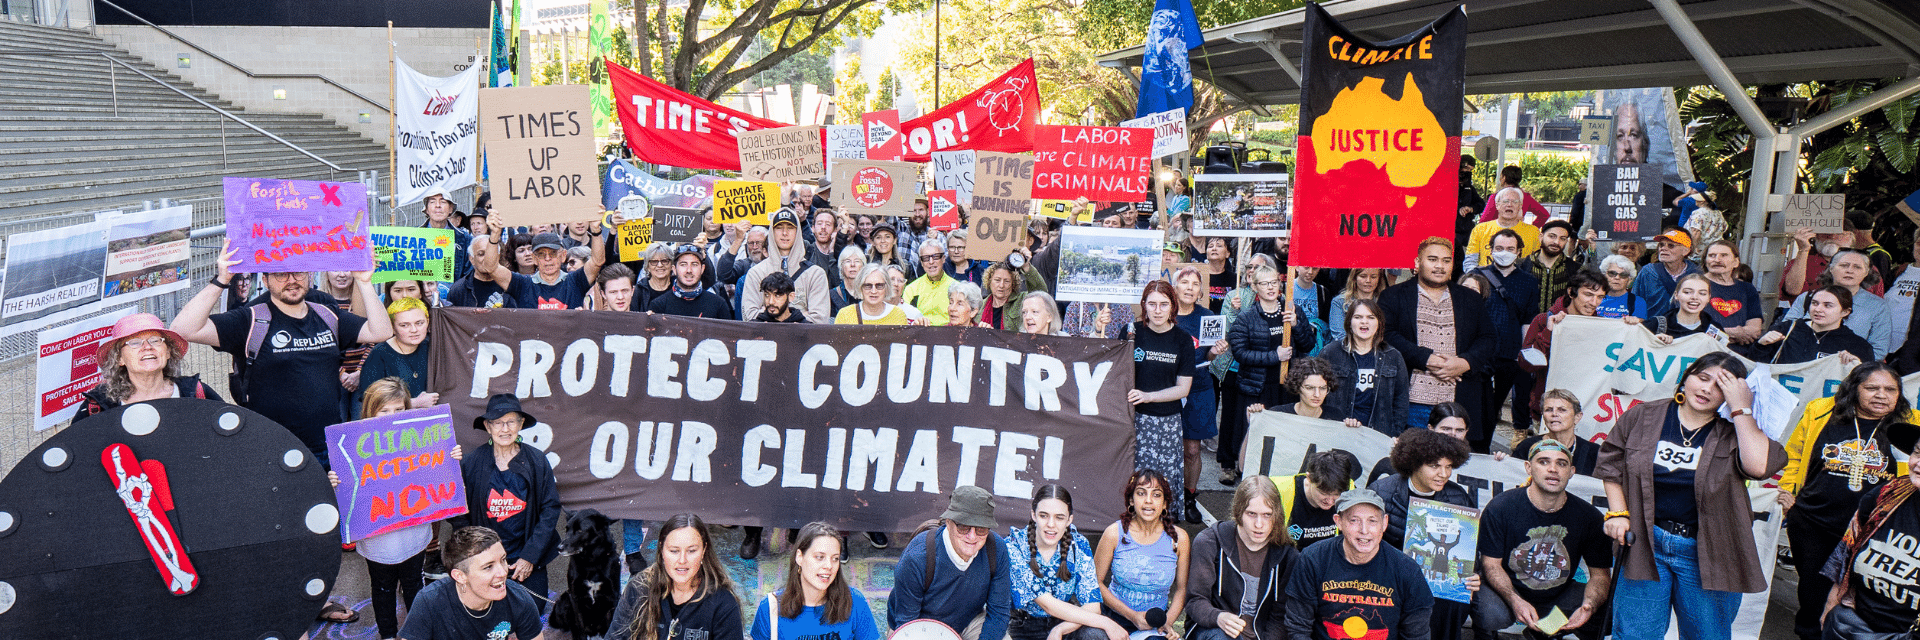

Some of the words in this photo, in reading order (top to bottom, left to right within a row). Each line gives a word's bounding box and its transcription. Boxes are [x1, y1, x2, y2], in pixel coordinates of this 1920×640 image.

[1329, 35, 1433, 65] CLIMATE
[632, 94, 750, 138] TIME'S
[1156, 113, 1173, 123] TIME
[1175, 111, 1183, 119] TO
[497, 110, 581, 139] TIME'S
[1588, 122, 1605, 130] TAXI
[765, 131, 804, 147] BELONGS
[807, 130, 818, 142] IN
[831, 129, 864, 140] SCIEN
[1061, 128, 1131, 146] LABOR
[1330, 128, 1424, 153] JUSTICE
[743, 152, 761, 162] THE
[762, 146, 796, 161] HISTORY
[797, 143, 821, 157] BOOKS
[839, 140, 866, 149] BACKE
[528, 147, 559, 171] UP
[787, 158, 805, 167] NOT
[934, 154, 952, 172] No
[955, 153, 974, 167] NEW
[1035, 150, 1057, 163] are
[1063, 152, 1150, 174] CLIMATE
[776, 167, 794, 179] OUR
[980, 156, 1034, 181] TIME
[1617, 167, 1639, 180] BAN
[508, 174, 586, 201] LABOR
[609, 164, 707, 199] Catholics
[859, 175, 880, 185] Fossil
[943, 171, 975, 194] GAS
[1036, 173, 1147, 194] CRIMINALS
[1615, 181, 1640, 193] NEW
[250, 181, 300, 199] Fossil
[716, 184, 764, 199] CLIMATE
[870, 184, 884, 194] Ban
[993, 181, 1012, 197] IS
[725, 193, 766, 206] ACTION
[972, 199, 1031, 216] RUNNING
[1607, 194, 1635, 206] COAL
[1638, 194, 1647, 206] &
[1785, 195, 1844, 210] AUKUS
[720, 201, 766, 221] NOW
[1615, 207, 1638, 219] GAS
[623, 223, 652, 232] CLIMAT
[664, 213, 696, 229] DIRTY
[1339, 213, 1398, 238] NOW
[1613, 220, 1639, 233] NOW
[1785, 219, 1817, 227] DEATH
[1818, 219, 1842, 228] CULT
[252, 223, 322, 239] Nuclear
[670, 229, 687, 237] COAL
[976, 216, 1028, 247] OUT!
[371, 233, 427, 249] NUCLEAR
[393, 251, 407, 263] IS
[410, 248, 443, 262] ZERO
[4, 301, 24, 314] THE
[26, 293, 56, 309] HARSH
[57, 281, 97, 301] REALITY??
[41, 343, 62, 355] COME
[63, 340, 73, 349] ON
[73, 334, 92, 347] LABOR
[93, 329, 106, 339] YOU
[294, 333, 334, 347] REPLANET
[1146, 350, 1178, 359] TOMORROW
[1146, 355, 1177, 364] MOVEMENT
[470, 335, 778, 402] PROTECT
[798, 343, 1114, 416] COUNTRY
[45, 386, 73, 402] PROTECT
[73, 376, 98, 392] RAMSAR
[63, 396, 78, 407] SAVE
[356, 422, 453, 460] CLIMATE
[361, 449, 446, 487] ACTION
[590, 421, 718, 484] OUR
[742, 423, 1064, 499] CLIMATE!
[370, 481, 457, 523] NOW
[490, 504, 523, 512] BEYOND
[491, 498, 514, 506] MOVE
[1412, 501, 1439, 510] CLIMATE
[1439, 504, 1462, 515] ACTION
[1462, 510, 1477, 518] NOW
[1304, 524, 1337, 534] TOMORROW
[1863, 548, 1920, 586] TREA
[1322, 580, 1395, 598] Aboriginal
[1322, 592, 1395, 608] AUSTRALIA
